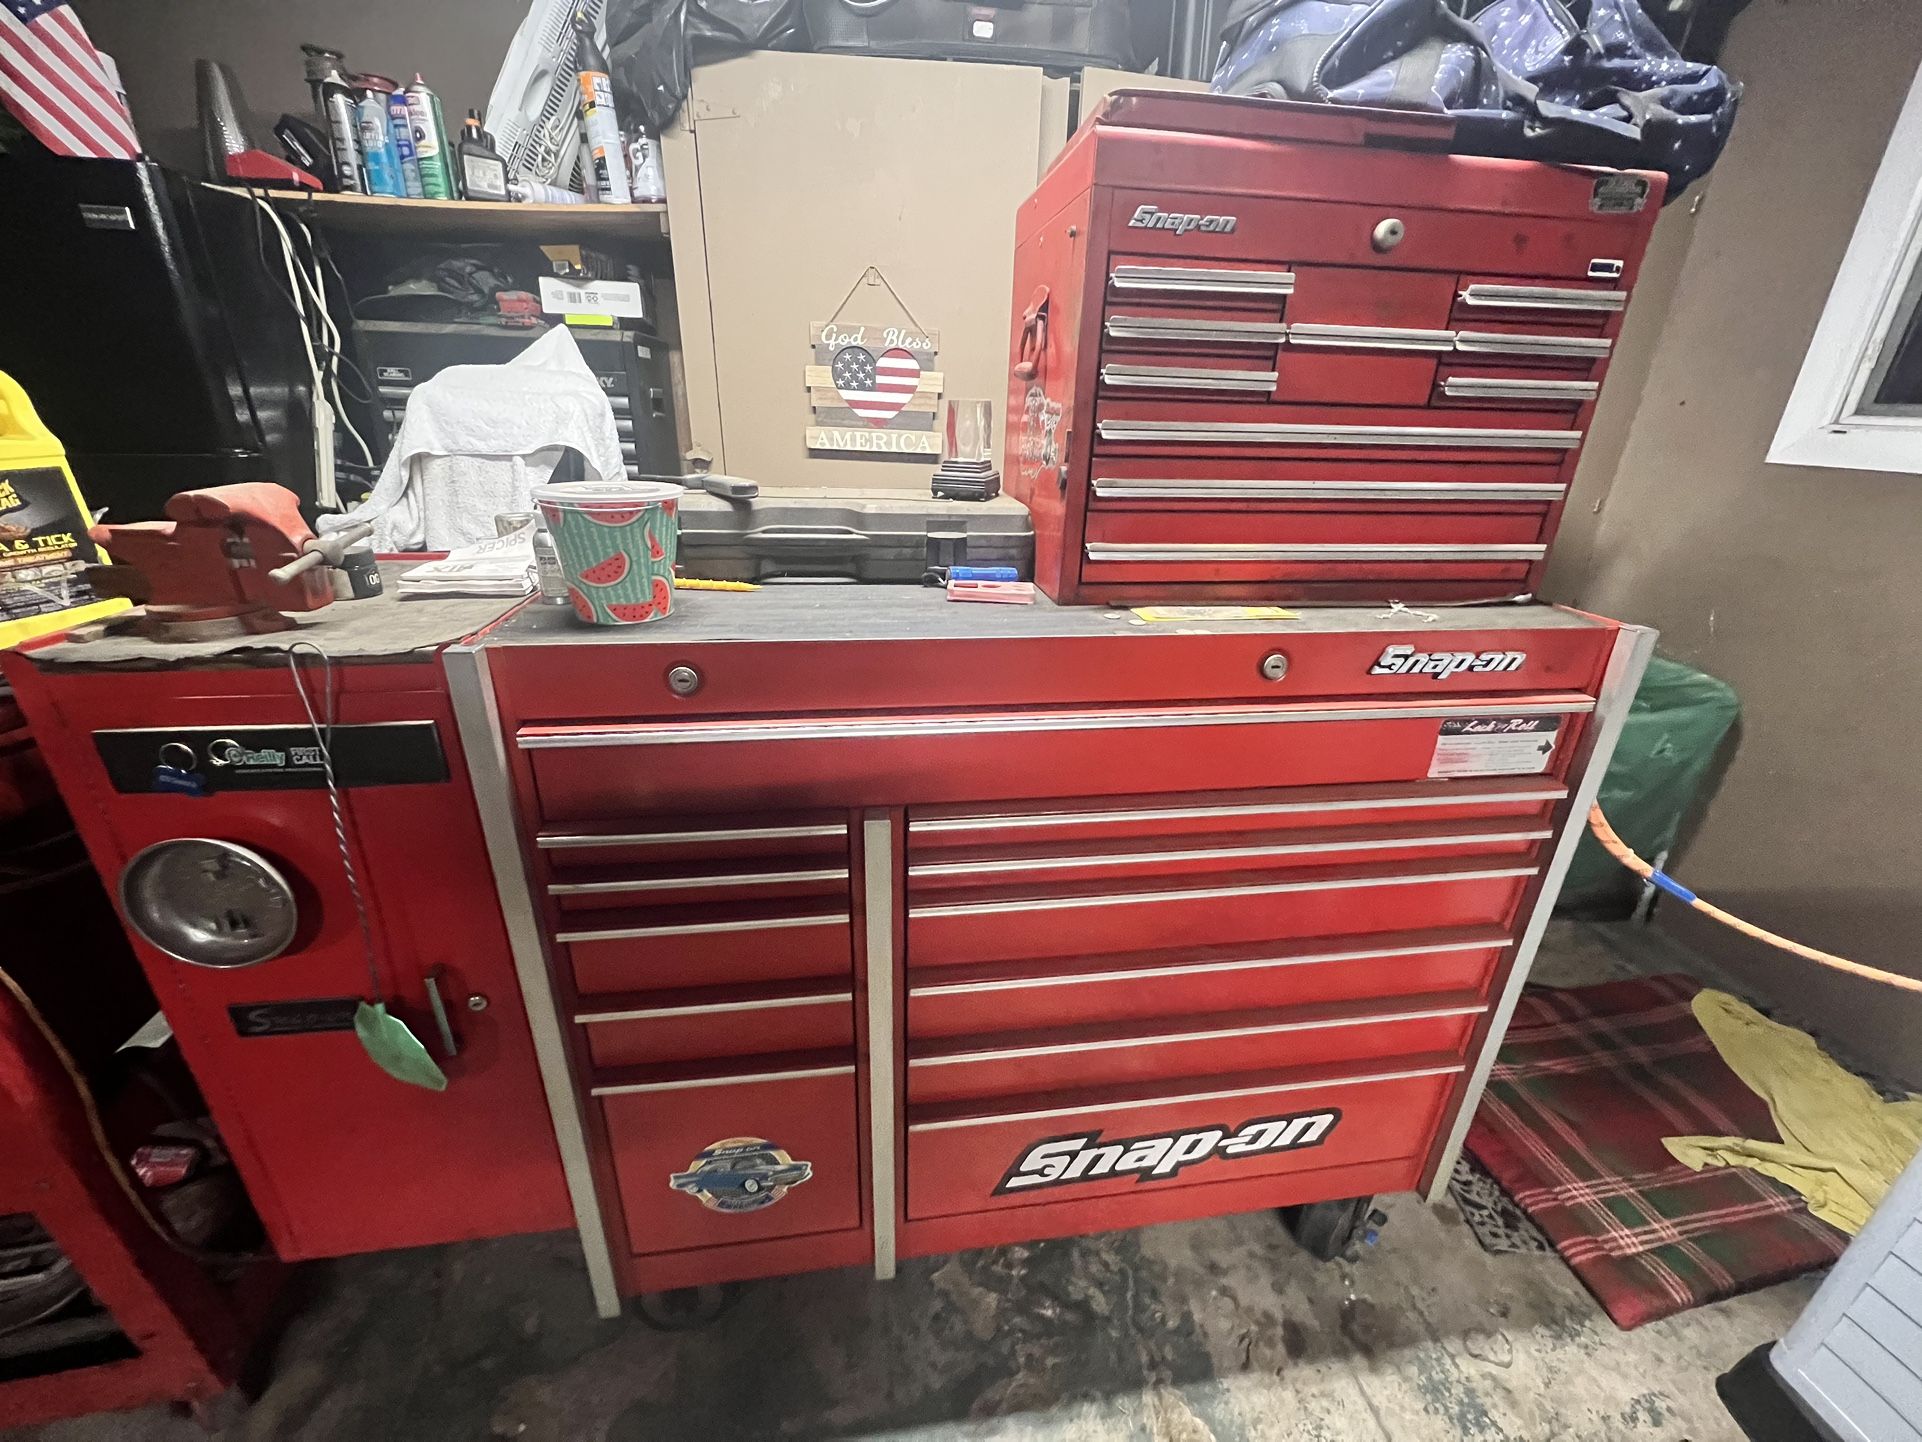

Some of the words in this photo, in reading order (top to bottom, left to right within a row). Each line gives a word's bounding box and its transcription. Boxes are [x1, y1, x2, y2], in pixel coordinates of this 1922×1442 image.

[1128, 205, 1237, 235] Snap-on
[821, 325, 867, 350] God
[883, 328, 931, 349] Bless
[815, 430, 931, 452] AMERICA
[32, 532, 76, 547] TICK
[476, 531, 526, 554] SPICER
[1371, 644, 1527, 680] Snap-on
[1503, 719, 1540, 733] Roll
[1005, 1113, 1335, 1189] Snap-on
